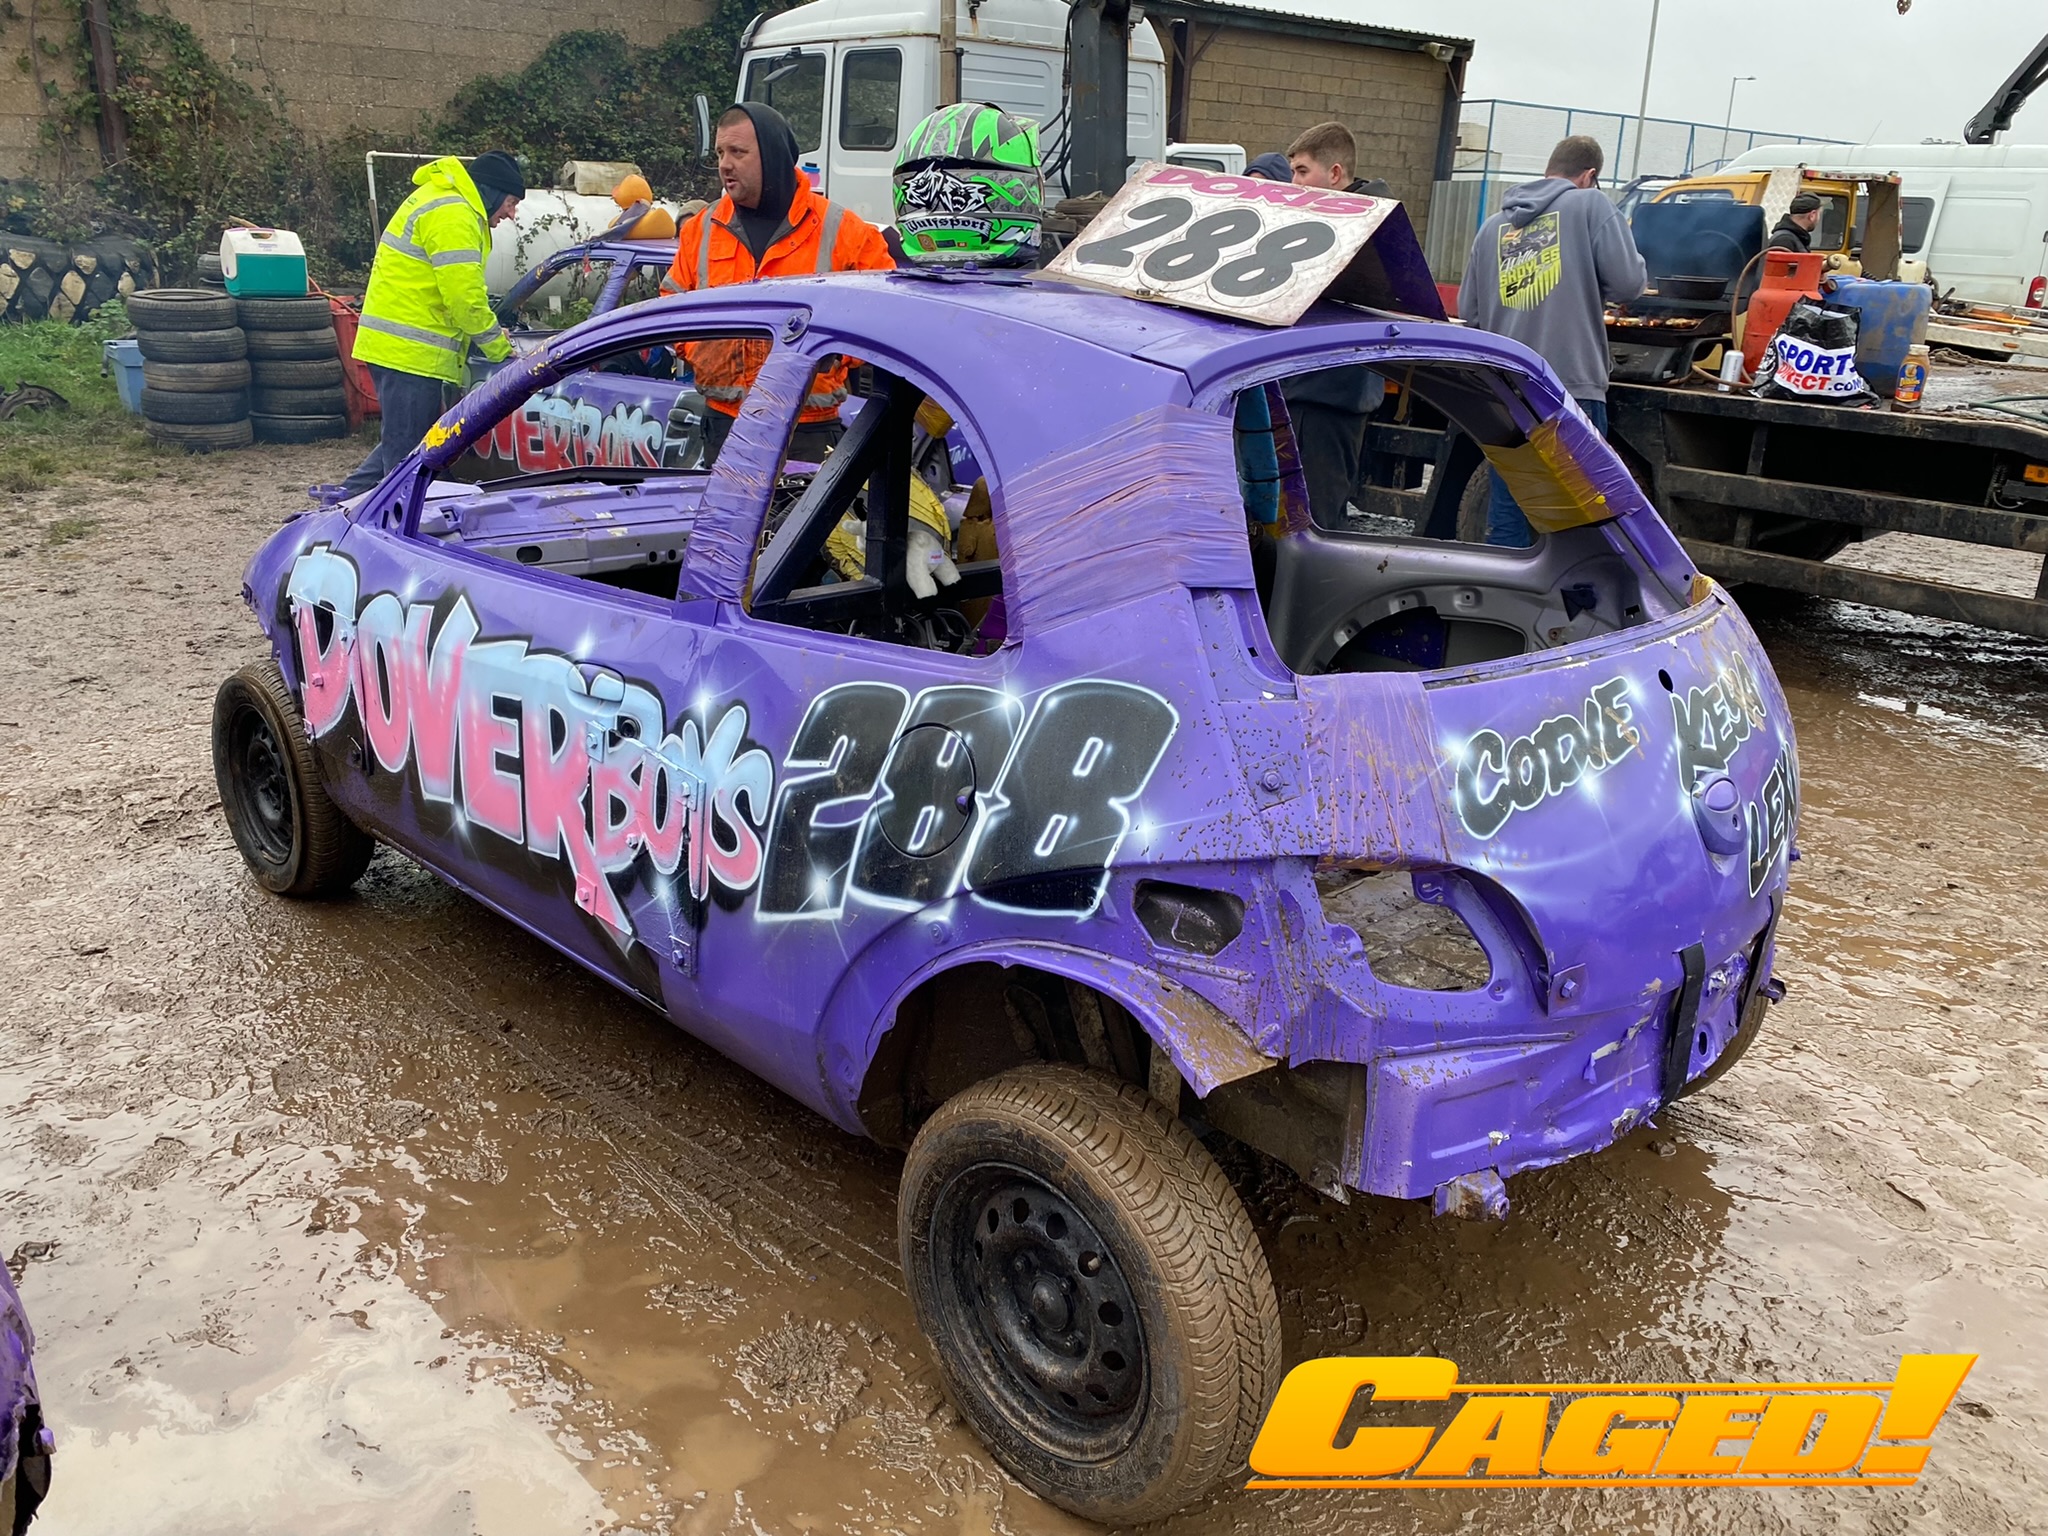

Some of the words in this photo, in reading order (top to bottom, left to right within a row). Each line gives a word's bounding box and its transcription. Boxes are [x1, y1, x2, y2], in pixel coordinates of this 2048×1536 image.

[905, 218, 987, 233] Wulfsport
[1148, 168, 1377, 215] DORIS
[1076, 197, 1336, 297] 288
[754, 679, 1180, 922] 288
[1456, 676, 1640, 841] CODIE
